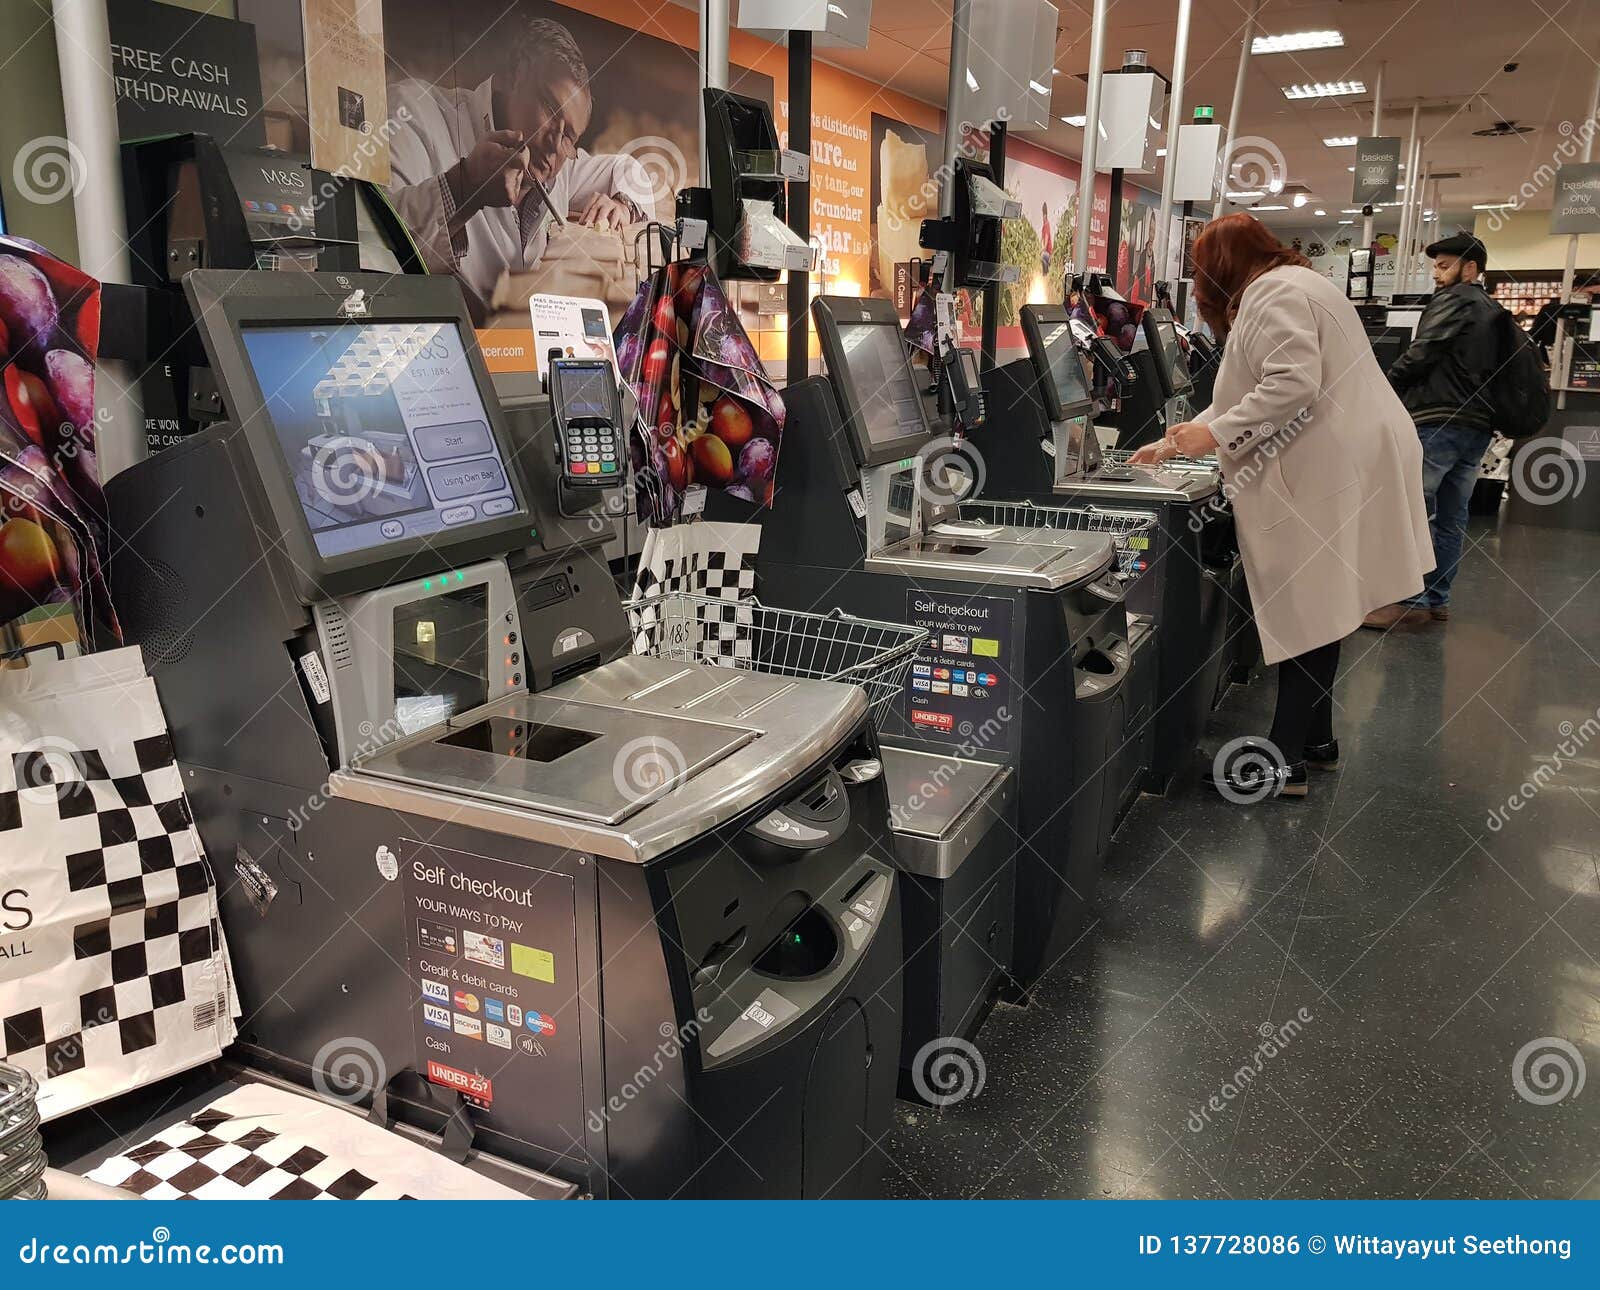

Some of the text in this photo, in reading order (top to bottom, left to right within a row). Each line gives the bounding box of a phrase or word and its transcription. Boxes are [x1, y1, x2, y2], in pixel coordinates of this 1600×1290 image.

[171, 57, 229, 85] CASH
[114, 76, 248, 117] ITHDRAWALS
[842, 159, 857, 172] and
[1361, 154, 1394, 162] baskets
[260, 168, 305, 188] M&S
[1368, 166, 1386, 175] only
[850, 185, 864, 198] our
[813, 198, 863, 222] Cruncher
[147, 434, 160, 445] OR
[444, 437, 464, 446] Start
[443, 471, 495, 488] Using Own Bag
[914, 600, 989, 618] Self checkout
[669, 621, 690, 645] &S
[914, 619, 982, 633] YOUR WAYS TO PAY
[940, 657, 955, 665] debit
[956, 660, 975, 668] cards
[912, 696, 929, 704] Cash
[914, 712, 938, 723] UNDER
[413, 861, 445, 886] Self
[450, 872, 532, 907] checkout
[416, 897, 523, 934] YOUR WAYS TO PAY
[420, 960, 519, 998] Credit & debit cards
[425, 983, 448, 998] VISA
[427, 1008, 449, 1022] VISA
[425, 1036, 451, 1053] Cash
[431, 1065, 469, 1087] UNDER
